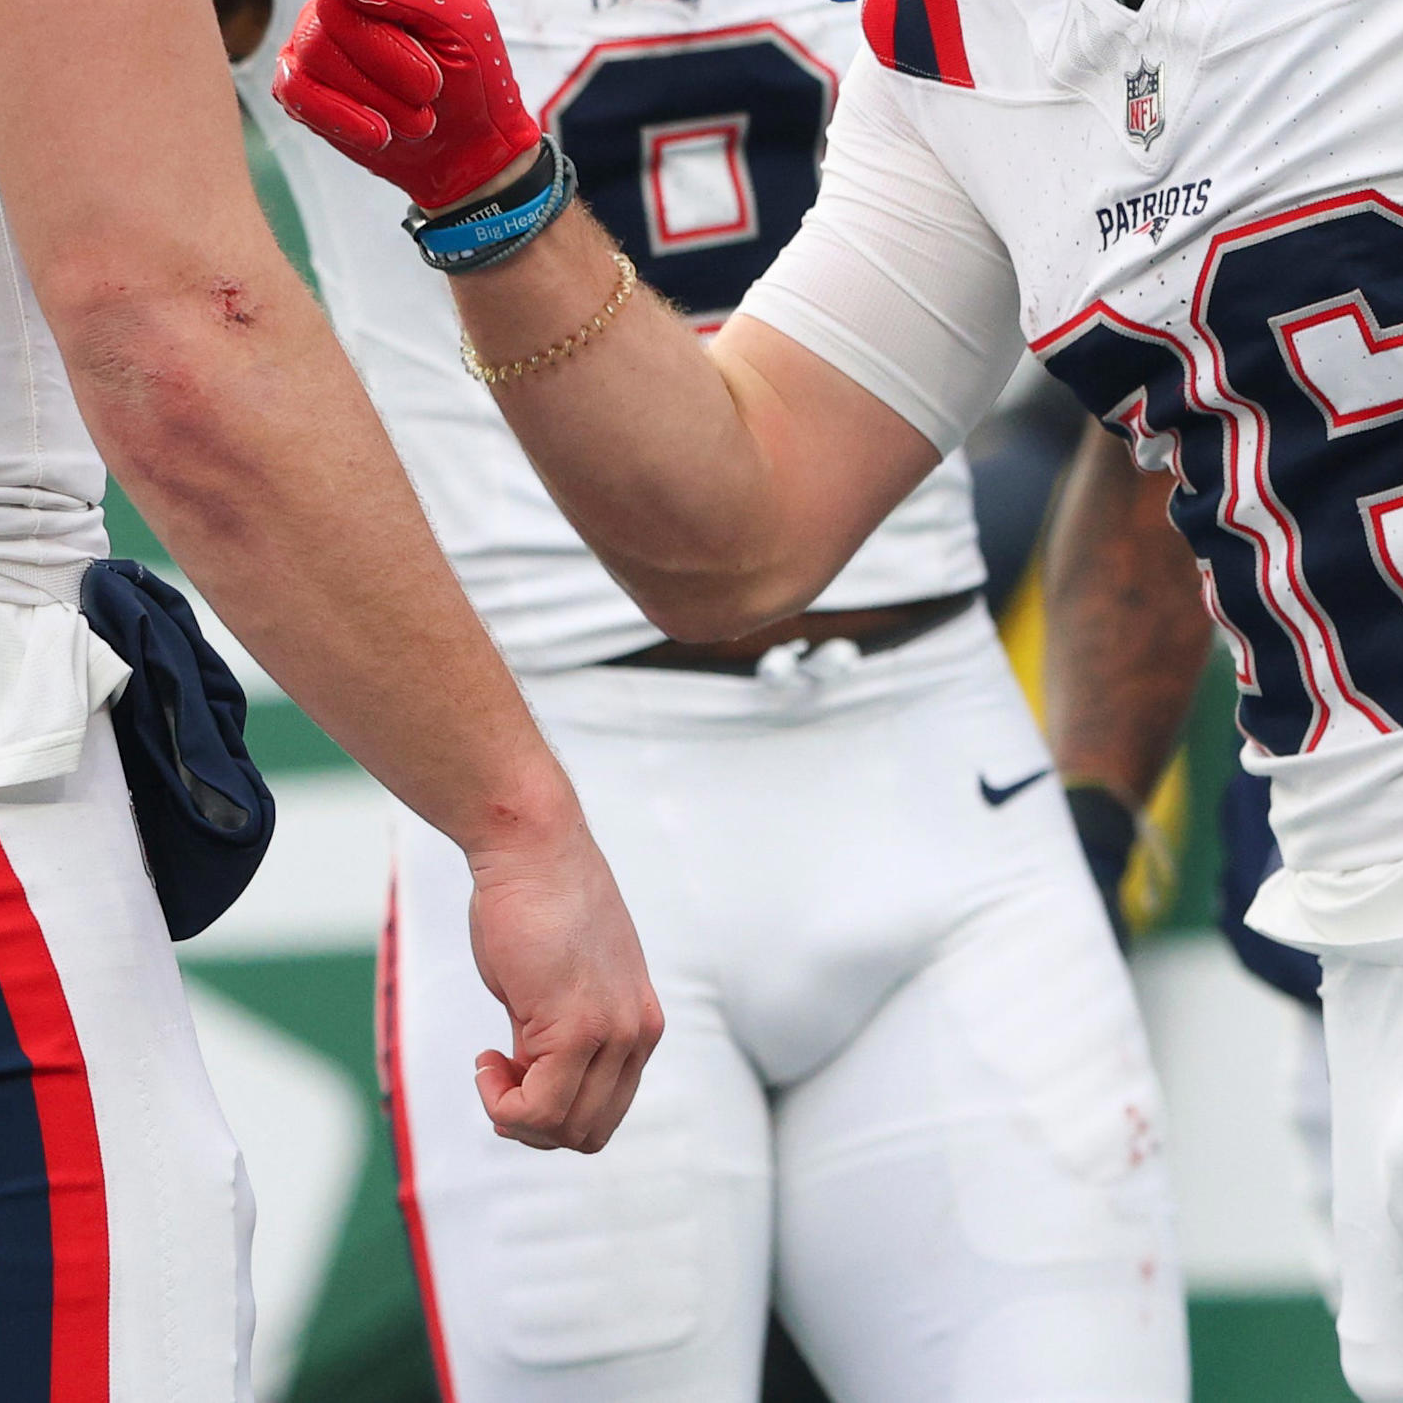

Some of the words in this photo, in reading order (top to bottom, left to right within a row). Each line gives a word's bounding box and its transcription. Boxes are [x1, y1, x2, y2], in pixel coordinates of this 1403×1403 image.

[1129, 96, 1157, 132] NFL
[1095, 178, 1213, 252] PATRIOTS
[475, 226, 503, 242] Big
